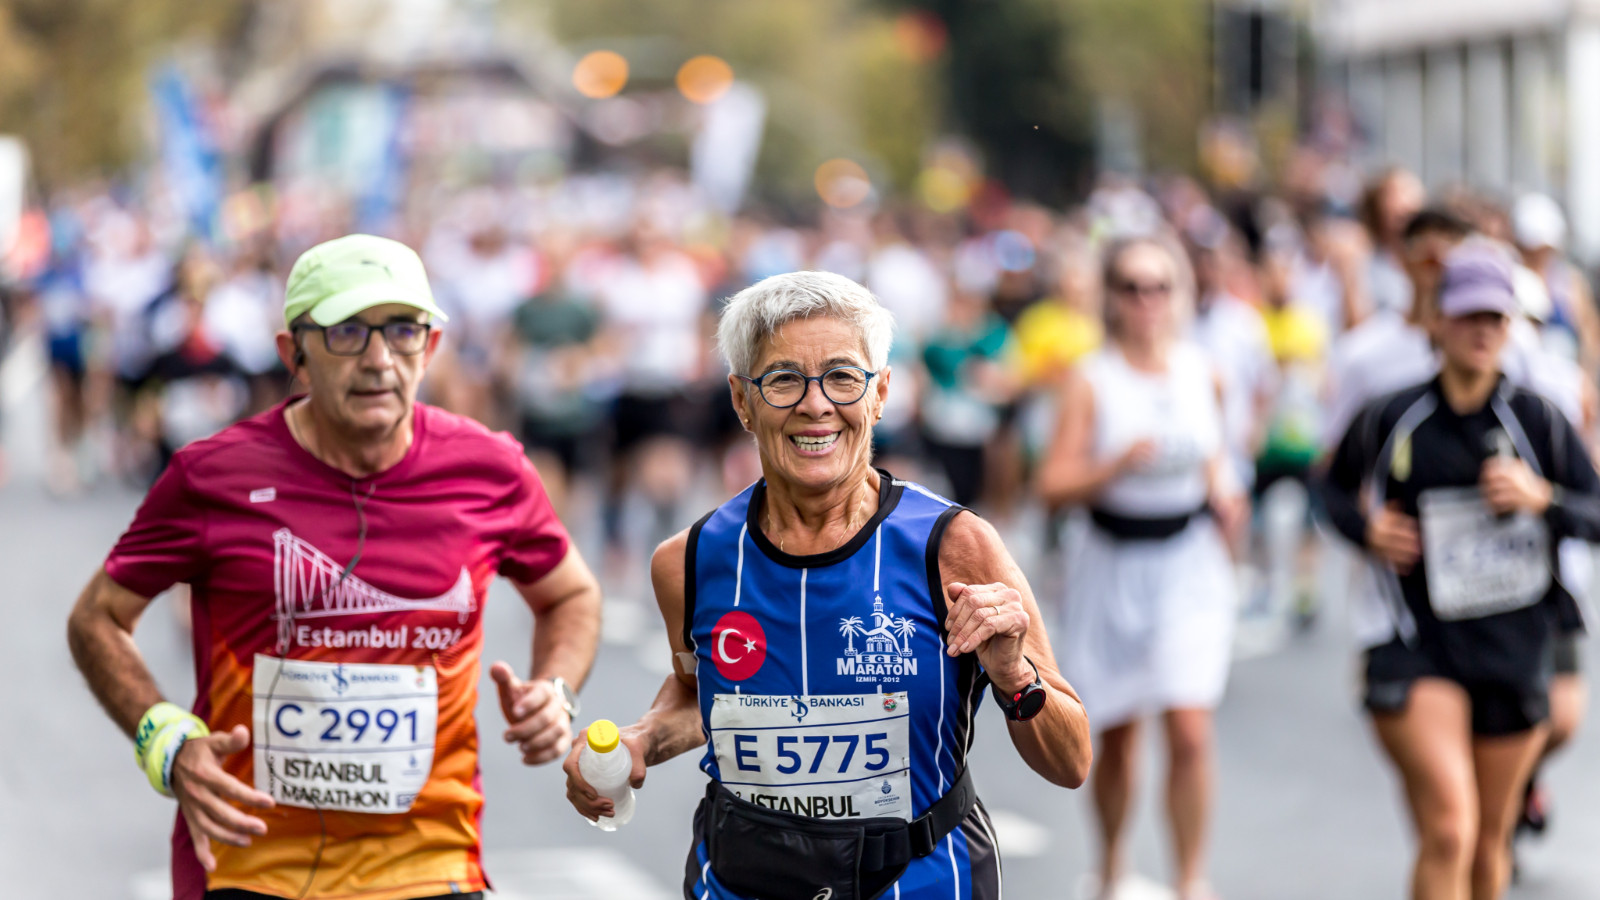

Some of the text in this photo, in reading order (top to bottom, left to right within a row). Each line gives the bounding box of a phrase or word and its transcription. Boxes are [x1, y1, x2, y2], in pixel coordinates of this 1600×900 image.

[297, 625, 407, 649] Estambul
[836, 657, 918, 676] MARATON
[861, 655, 899, 663] EGE
[738, 695, 865, 708] TÜRKİYE BANKASI
[275, 704, 417, 742] C 2991
[734, 732, 890, 775] E 5775
[283, 758, 387, 783] ISTANBUL
[281, 784, 389, 808] MARATHON
